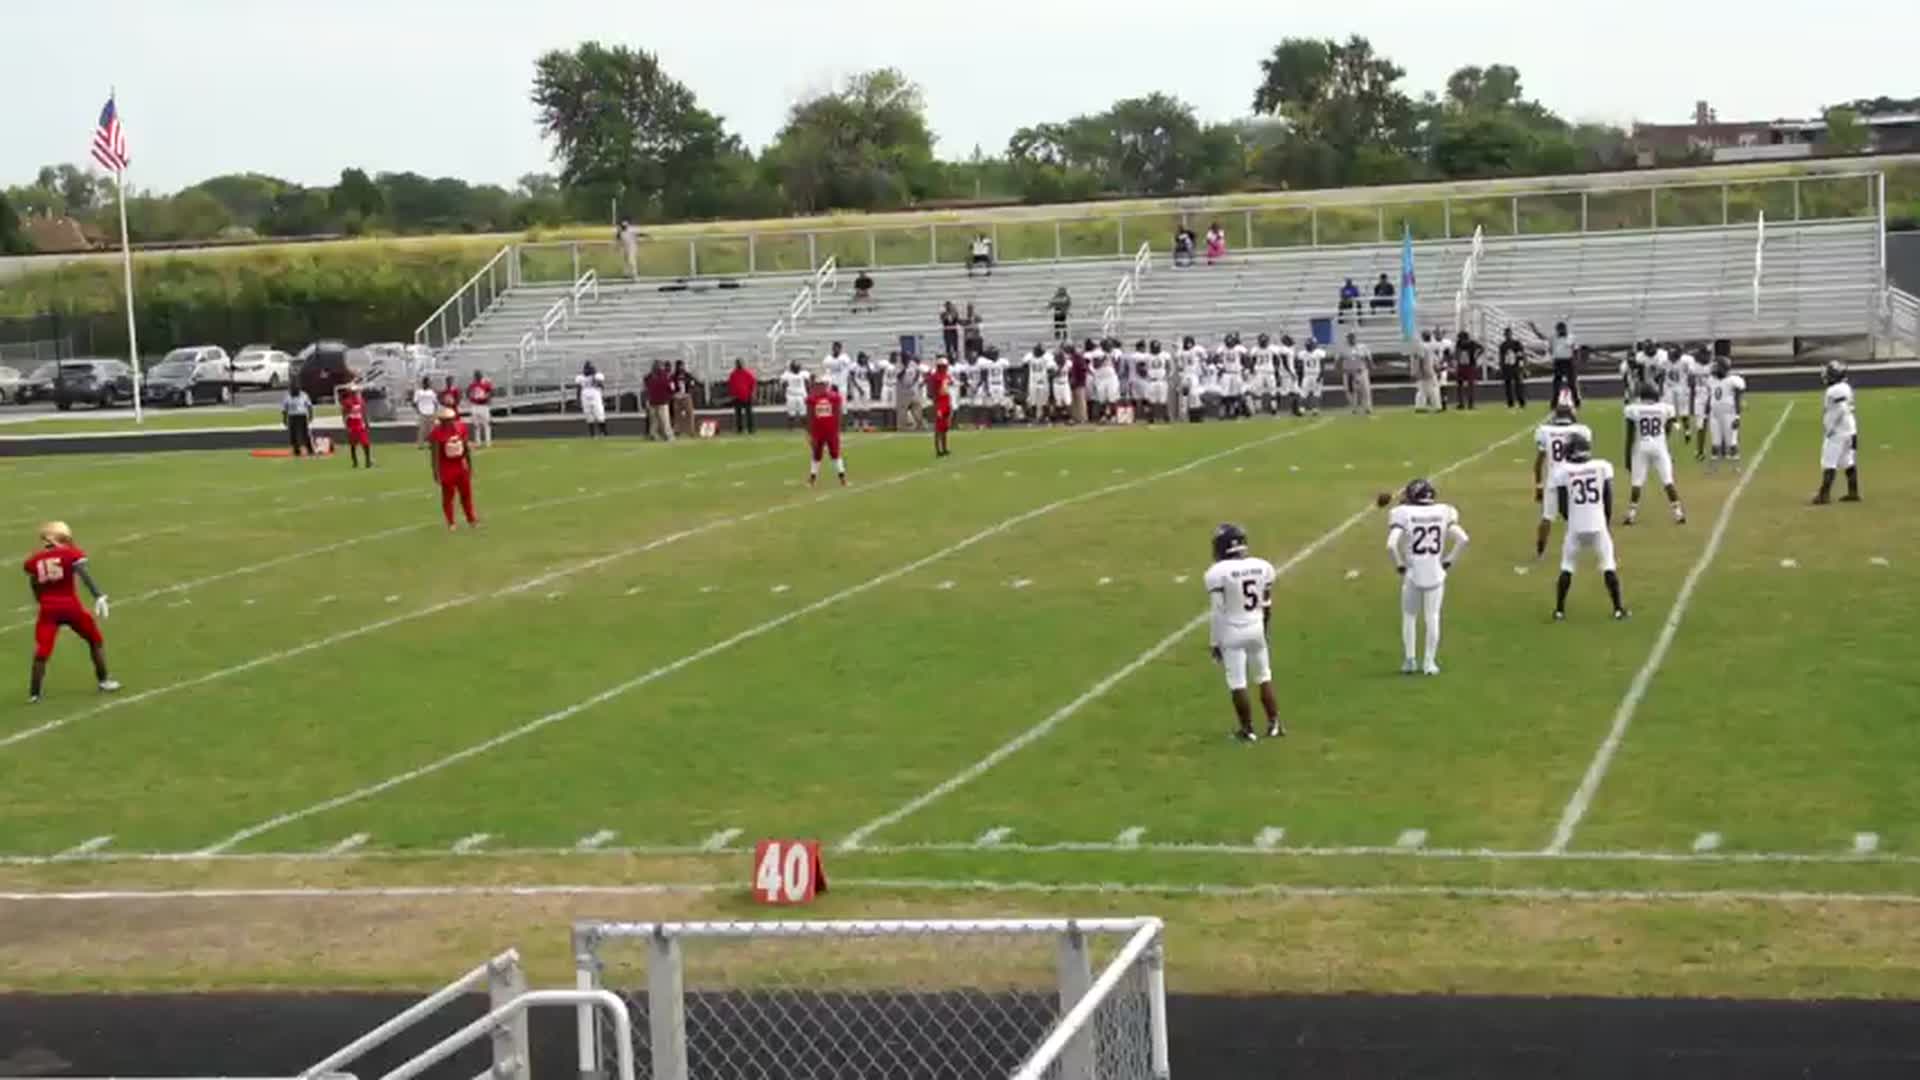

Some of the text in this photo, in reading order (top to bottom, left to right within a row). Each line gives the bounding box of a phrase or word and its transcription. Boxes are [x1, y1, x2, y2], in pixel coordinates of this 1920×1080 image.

[1640, 417, 1661, 437] 88
[1552, 439, 1568, 462] 8
[1572, 477, 1600, 504] 35
[1412, 525, 1441, 555] 23
[1242, 579, 1258, 611] 5
[757, 842, 809, 902] 40
